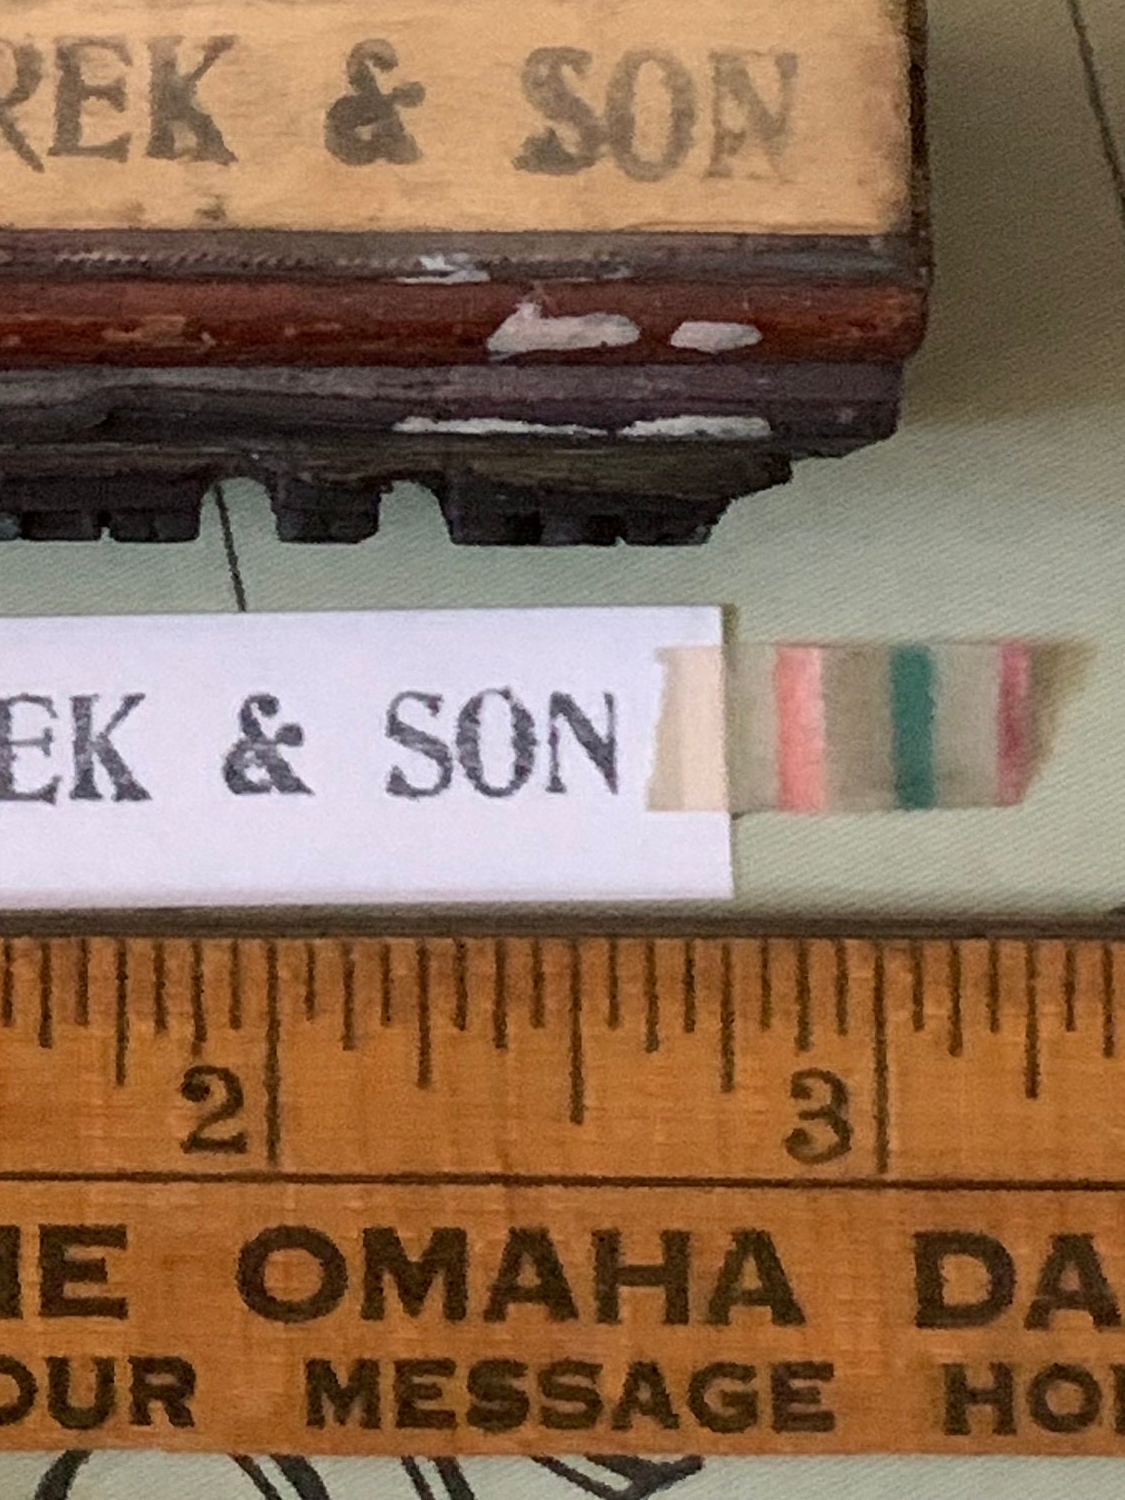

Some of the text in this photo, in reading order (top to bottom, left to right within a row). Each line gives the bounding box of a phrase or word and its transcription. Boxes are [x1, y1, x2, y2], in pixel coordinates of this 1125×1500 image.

[324, 38, 426, 167] &
[512, 44, 799, 183] SON
[222, 693, 315, 797] &
[384, 688, 618, 800] SON
[179, 1066, 249, 1155] 2
[783, 1069, 853, 1164] 3
[235, 1225, 806, 1329] OMAHA
[304, 1356, 837, 1434] MESSAGE
[942, 1362, 1125, 1436] HO
